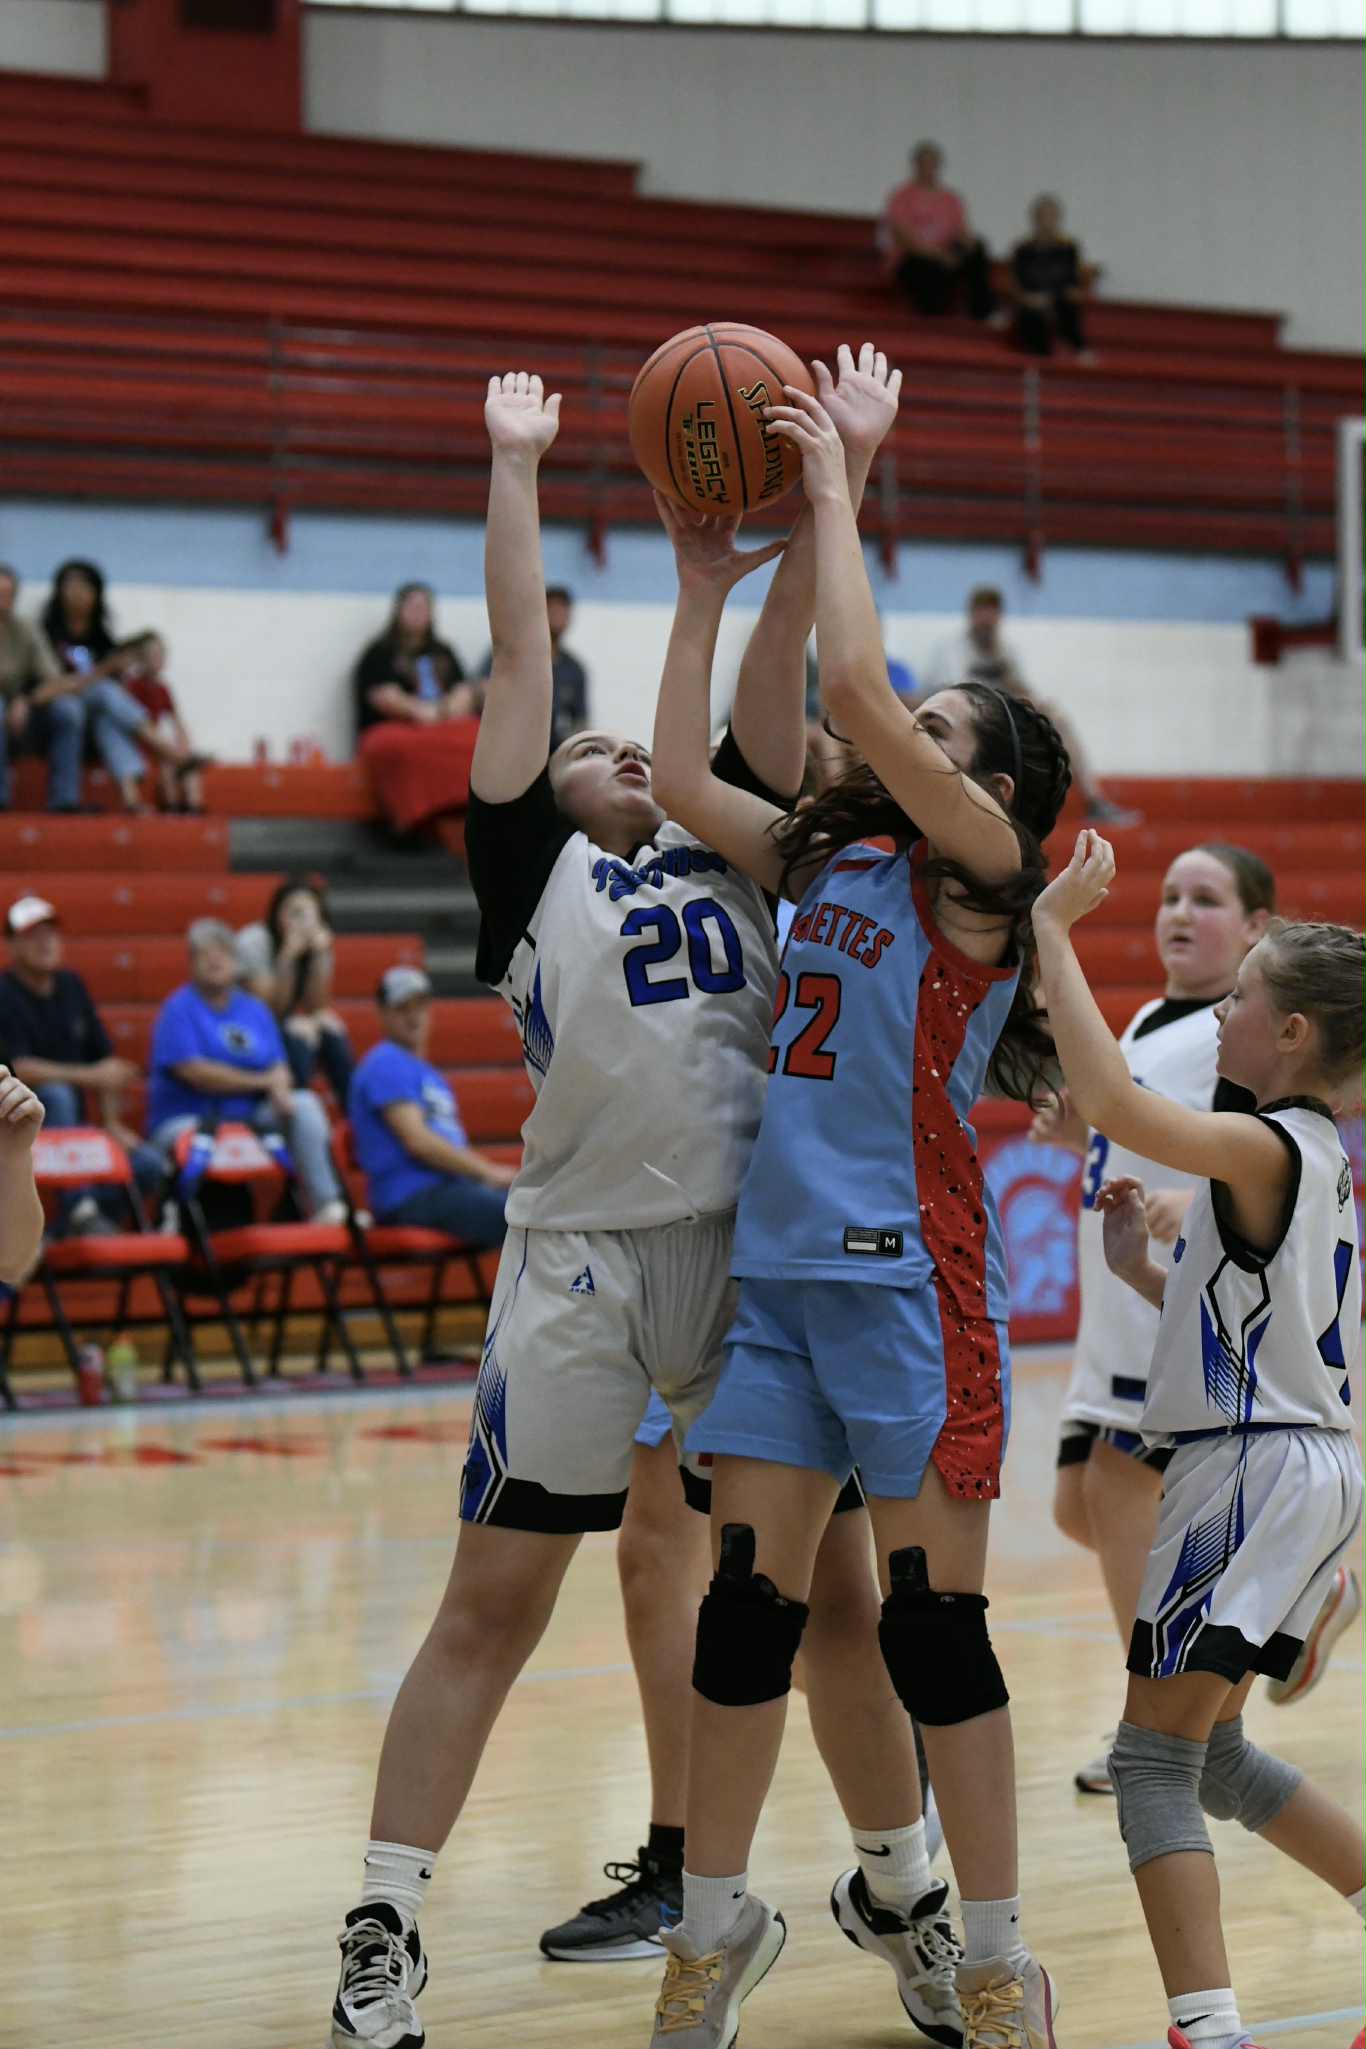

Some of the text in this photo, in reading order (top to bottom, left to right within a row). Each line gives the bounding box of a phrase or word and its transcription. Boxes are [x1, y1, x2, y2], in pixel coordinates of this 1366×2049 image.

[697, 401, 730, 504] LEGACY
[620, 896, 747, 1007] 20
[884, 1236, 896, 1249] M
